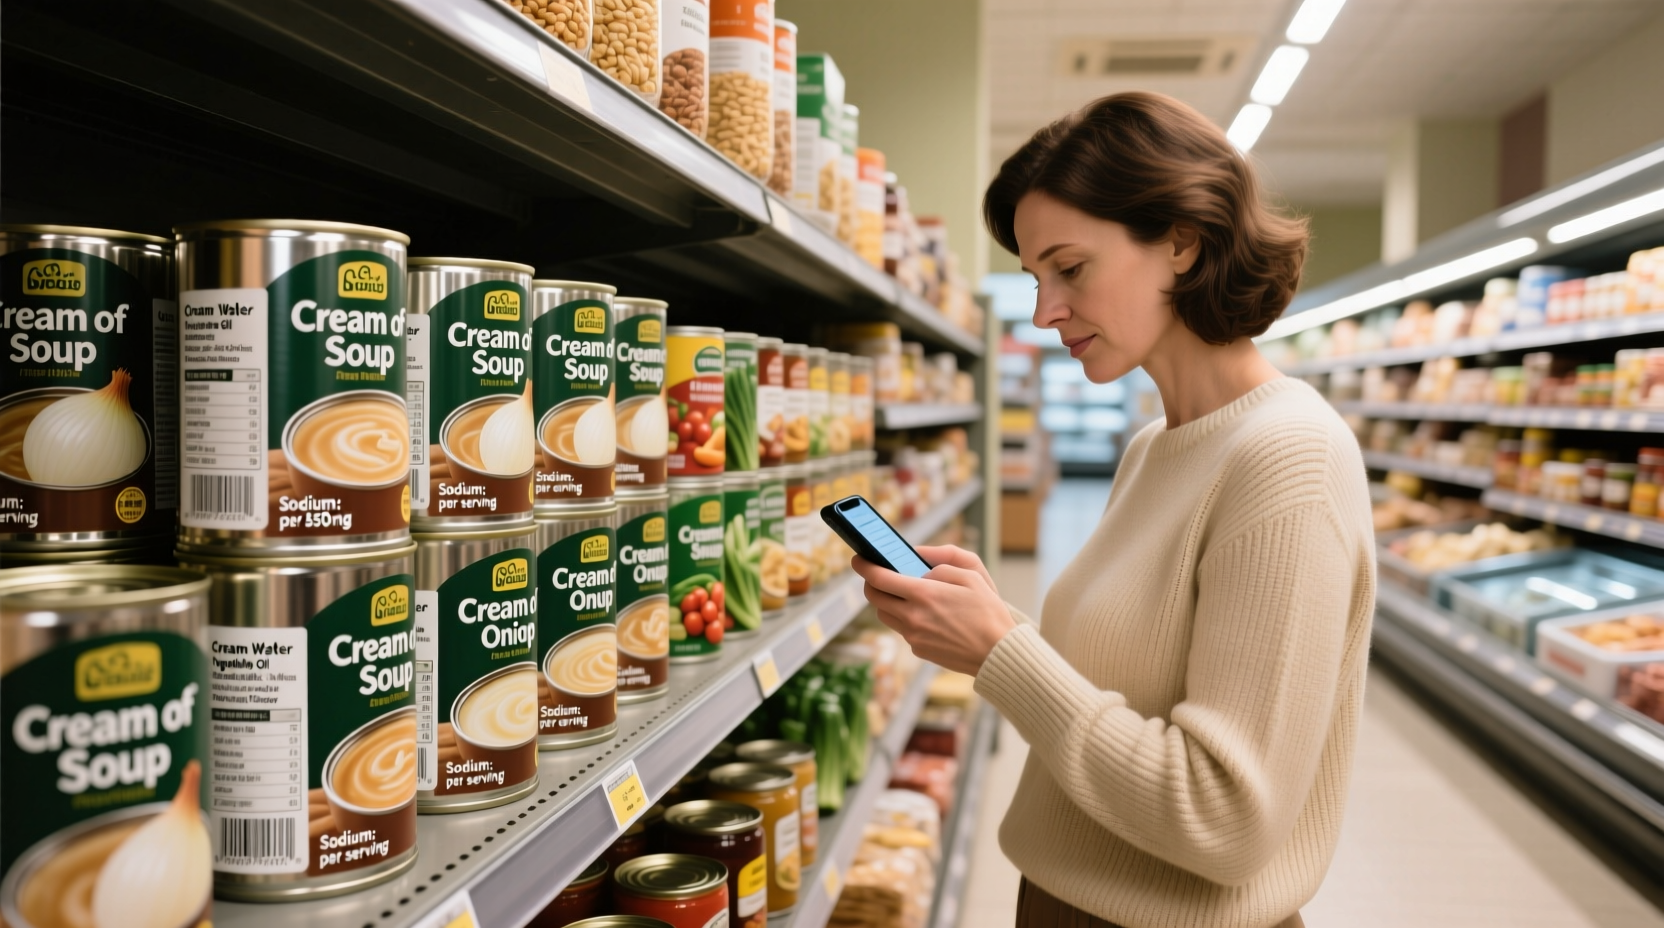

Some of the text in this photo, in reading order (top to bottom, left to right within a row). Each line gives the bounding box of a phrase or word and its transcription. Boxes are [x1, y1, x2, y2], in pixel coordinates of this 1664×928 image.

[0, 301, 129, 334] ream of
[291, 299, 406, 337] Cream of
[448, 321, 519, 349] Cream
[546, 334, 605, 357] Cream
[10, 333, 97, 371] Soup
[324, 335, 395, 376] Soup
[472, 349, 525, 384] Soup
[564, 358, 608, 386] Soup
[279, 495, 341, 512] Sodium:
[552, 567, 609, 589] Cream
[458, 597, 528, 624] Cream
[569, 590, 613, 613] Onup
[252, 642, 293, 655] Water
[328, 631, 408, 667] Cream
[359, 661, 414, 696] Soup
[12, 704, 159, 754] Cream
[161, 682, 199, 733] of
[56, 742, 172, 794] Soup
[320, 830, 376, 850] Sodium:
